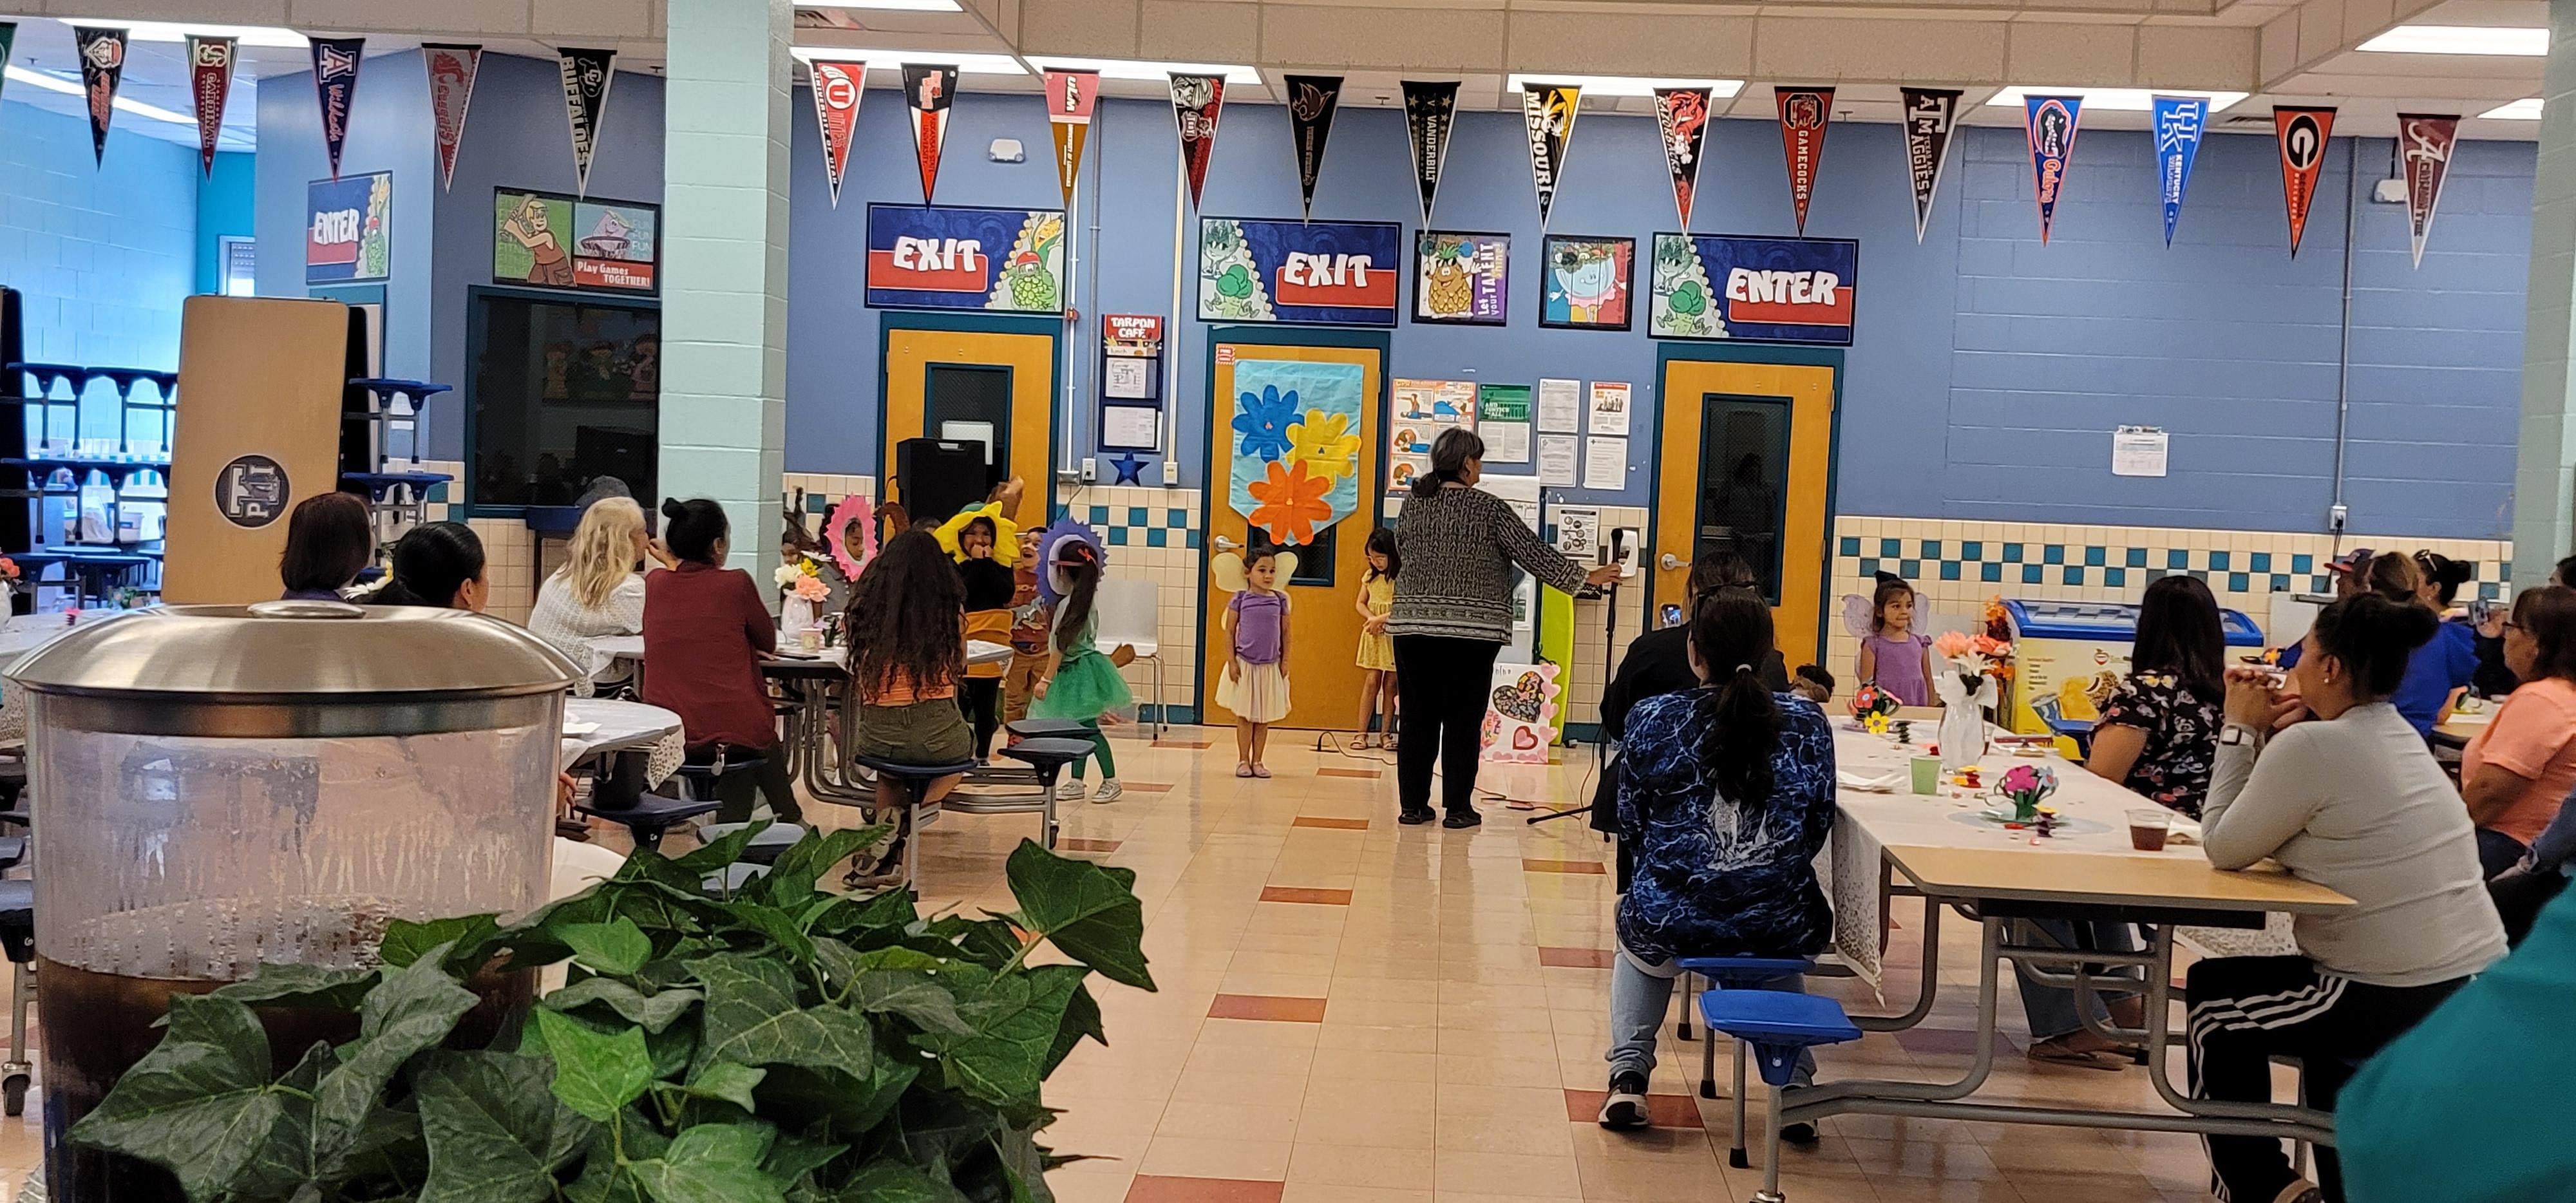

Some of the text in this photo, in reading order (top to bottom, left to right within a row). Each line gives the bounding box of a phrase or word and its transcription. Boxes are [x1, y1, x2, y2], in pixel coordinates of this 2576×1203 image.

[319, 44, 355, 84] A
[205, 72, 217, 148] CARDINAL
[561, 57, 589, 166] BUFFALOES
[829, 84, 849, 104] U
[814, 72, 838, 185] UNIVERSITY OF UTAH
[1426, 115, 1437, 183] VANDERBILT
[1525, 91, 1553, 193] MISSOURI
[1656, 95, 1682, 175] RAZORBACKS
[1924, 135, 1932, 159] TEXAS
[2160, 102, 2199, 152] UK
[2286, 115, 2320, 169] G
[2406, 122, 2447, 162] A
[1796, 130, 1809, 200] GAMECOCKS
[1911, 135, 1930, 191] AGGIES
[2040, 158, 2061, 203] Gators
[2172, 154, 2183, 205] KENTUCKY
[313, 207, 360, 245] ENTER
[577, 261, 629, 276] Play Games
[893, 236, 983, 272] EXIT
[1283, 251, 1372, 288] EXIT
[603, 274, 650, 287] TOGETHER!
[1479, 243, 1500, 316] your TALENT
[1725, 267, 1839, 307] ENTER
[1111, 317, 1155, 329] TARPON
[1477, 298, 1490, 316] Let
